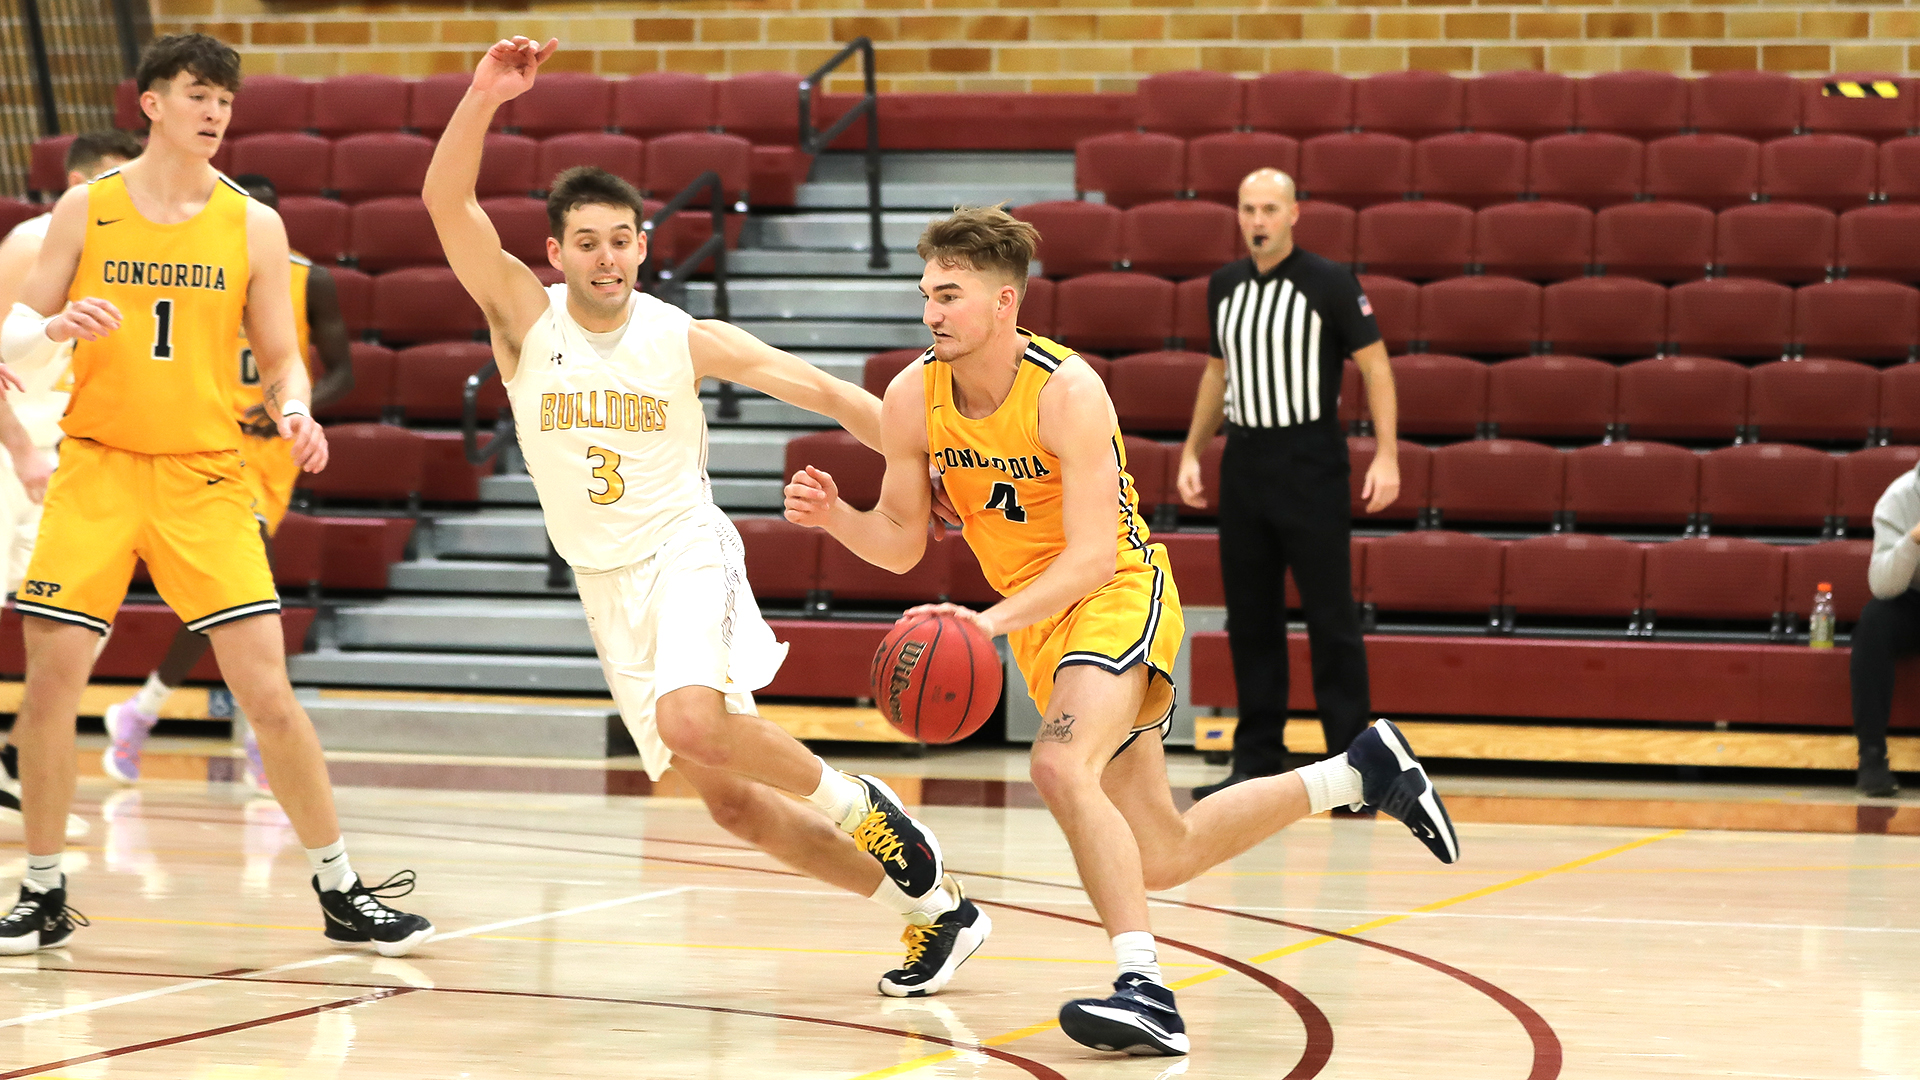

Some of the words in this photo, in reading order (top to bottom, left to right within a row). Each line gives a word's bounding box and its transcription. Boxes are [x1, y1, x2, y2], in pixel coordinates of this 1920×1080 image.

[103, 259, 226, 291] CONCORDIA
[152, 298, 174, 361] 1
[540, 390, 669, 432] BULLDOGS
[586, 445, 625, 505] 3
[934, 447, 1051, 480] CONCDIA
[983, 481, 1028, 524] 4
[25, 579, 62, 598] CSP
